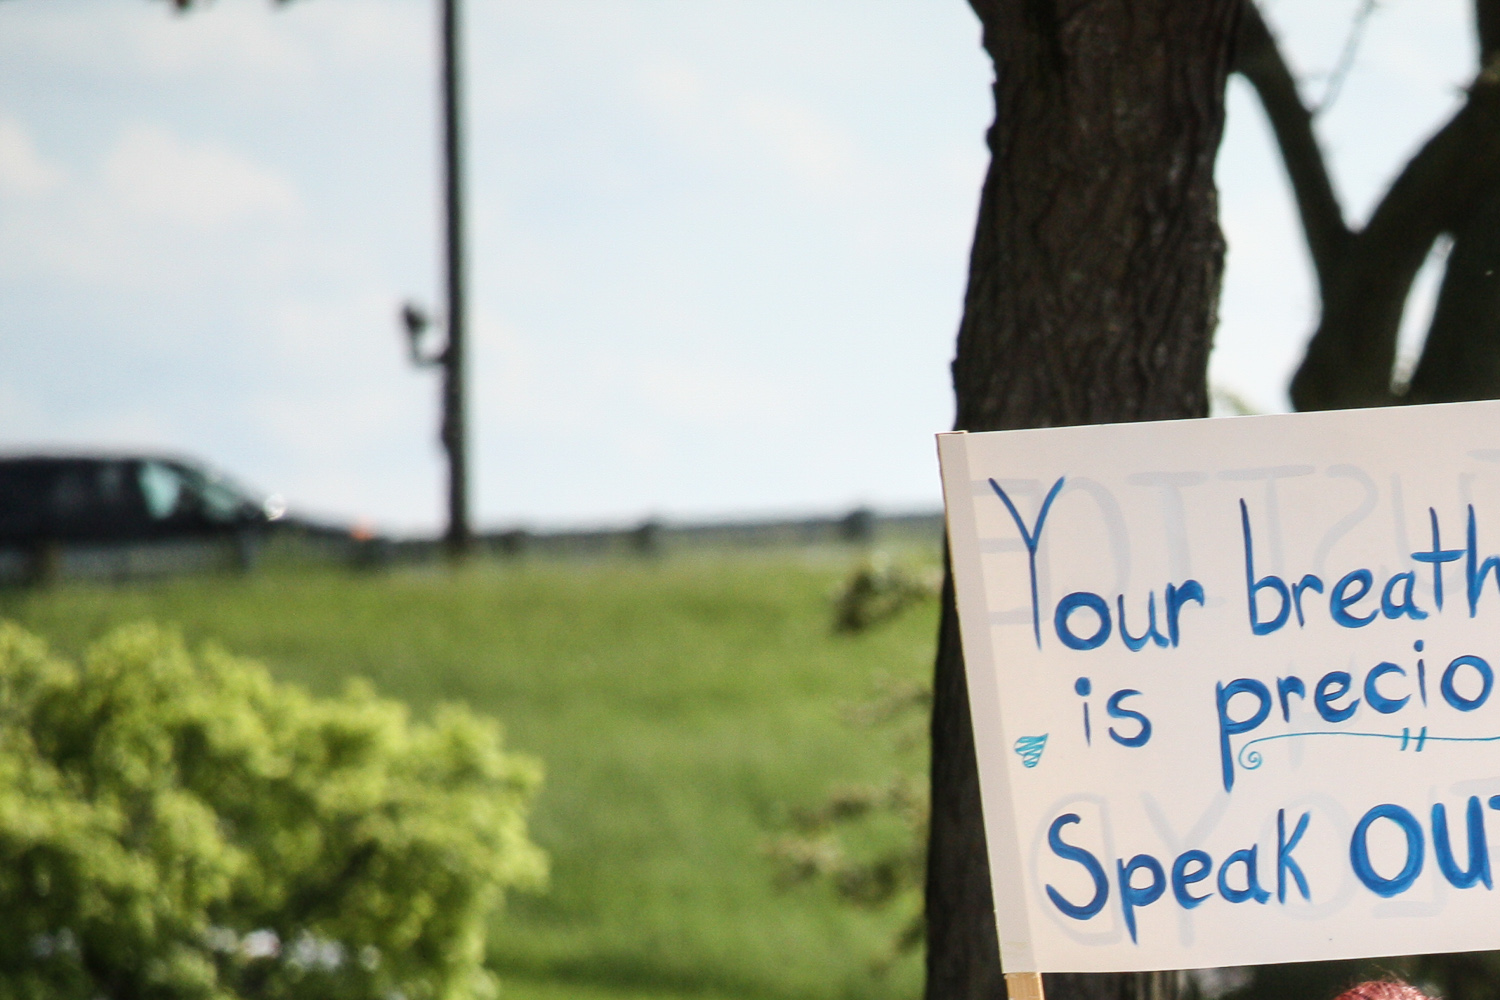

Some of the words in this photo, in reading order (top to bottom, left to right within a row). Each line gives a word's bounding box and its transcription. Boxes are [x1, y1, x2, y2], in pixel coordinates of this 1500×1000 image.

[987, 475, 1205, 650] Your
[1074, 676, 1153, 748] is
[1044, 808, 1313, 945] Speak
